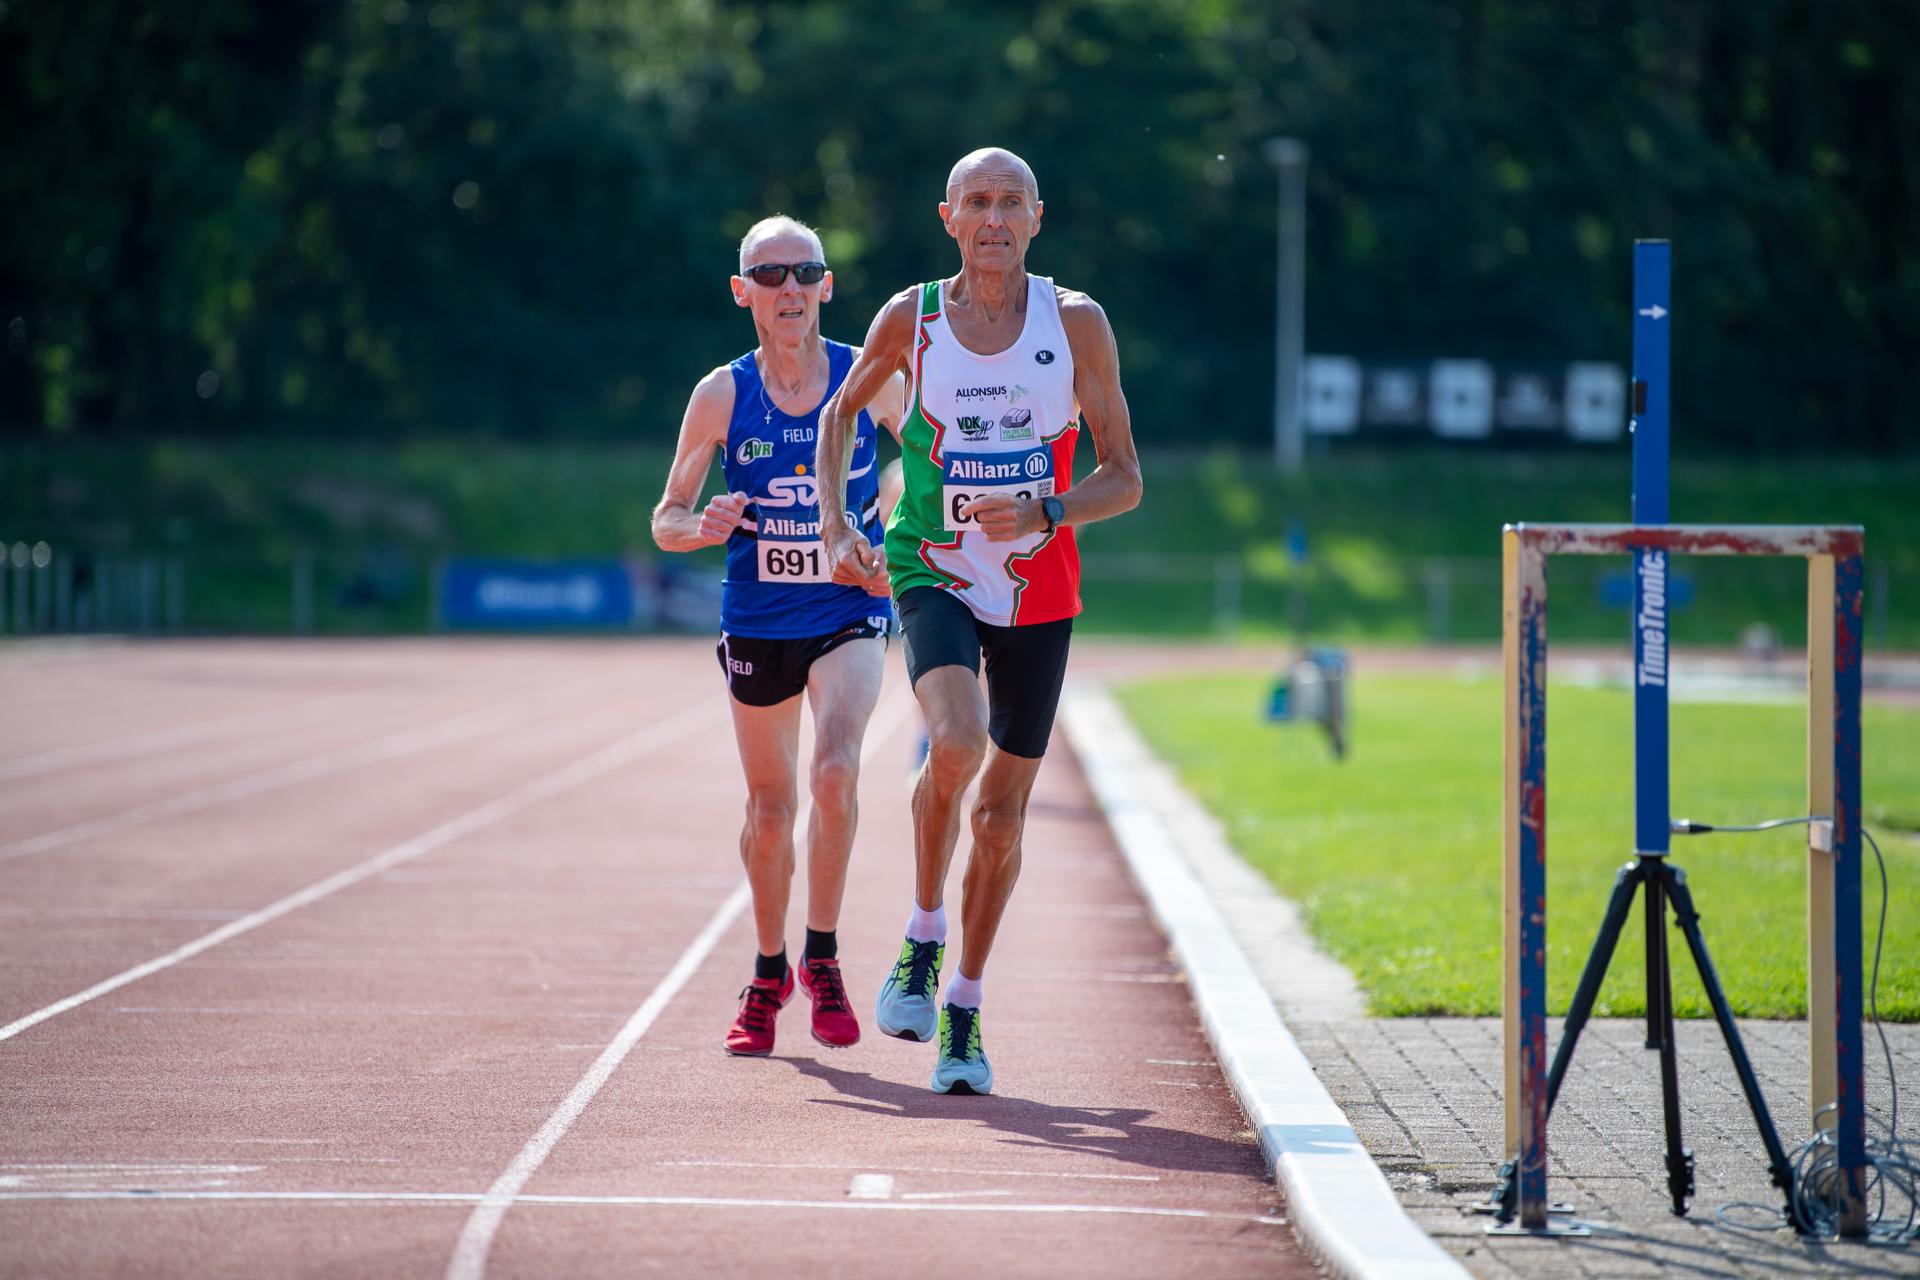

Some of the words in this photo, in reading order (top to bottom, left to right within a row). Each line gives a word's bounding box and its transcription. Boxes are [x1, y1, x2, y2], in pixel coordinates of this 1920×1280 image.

[955, 385, 1007, 398] ALLONSIUS
[949, 460, 1021, 479] Allianz
[763, 518, 820, 536] Allian
[766, 548, 819, 576] 691
[1638, 545, 1665, 687] TimeTronic
